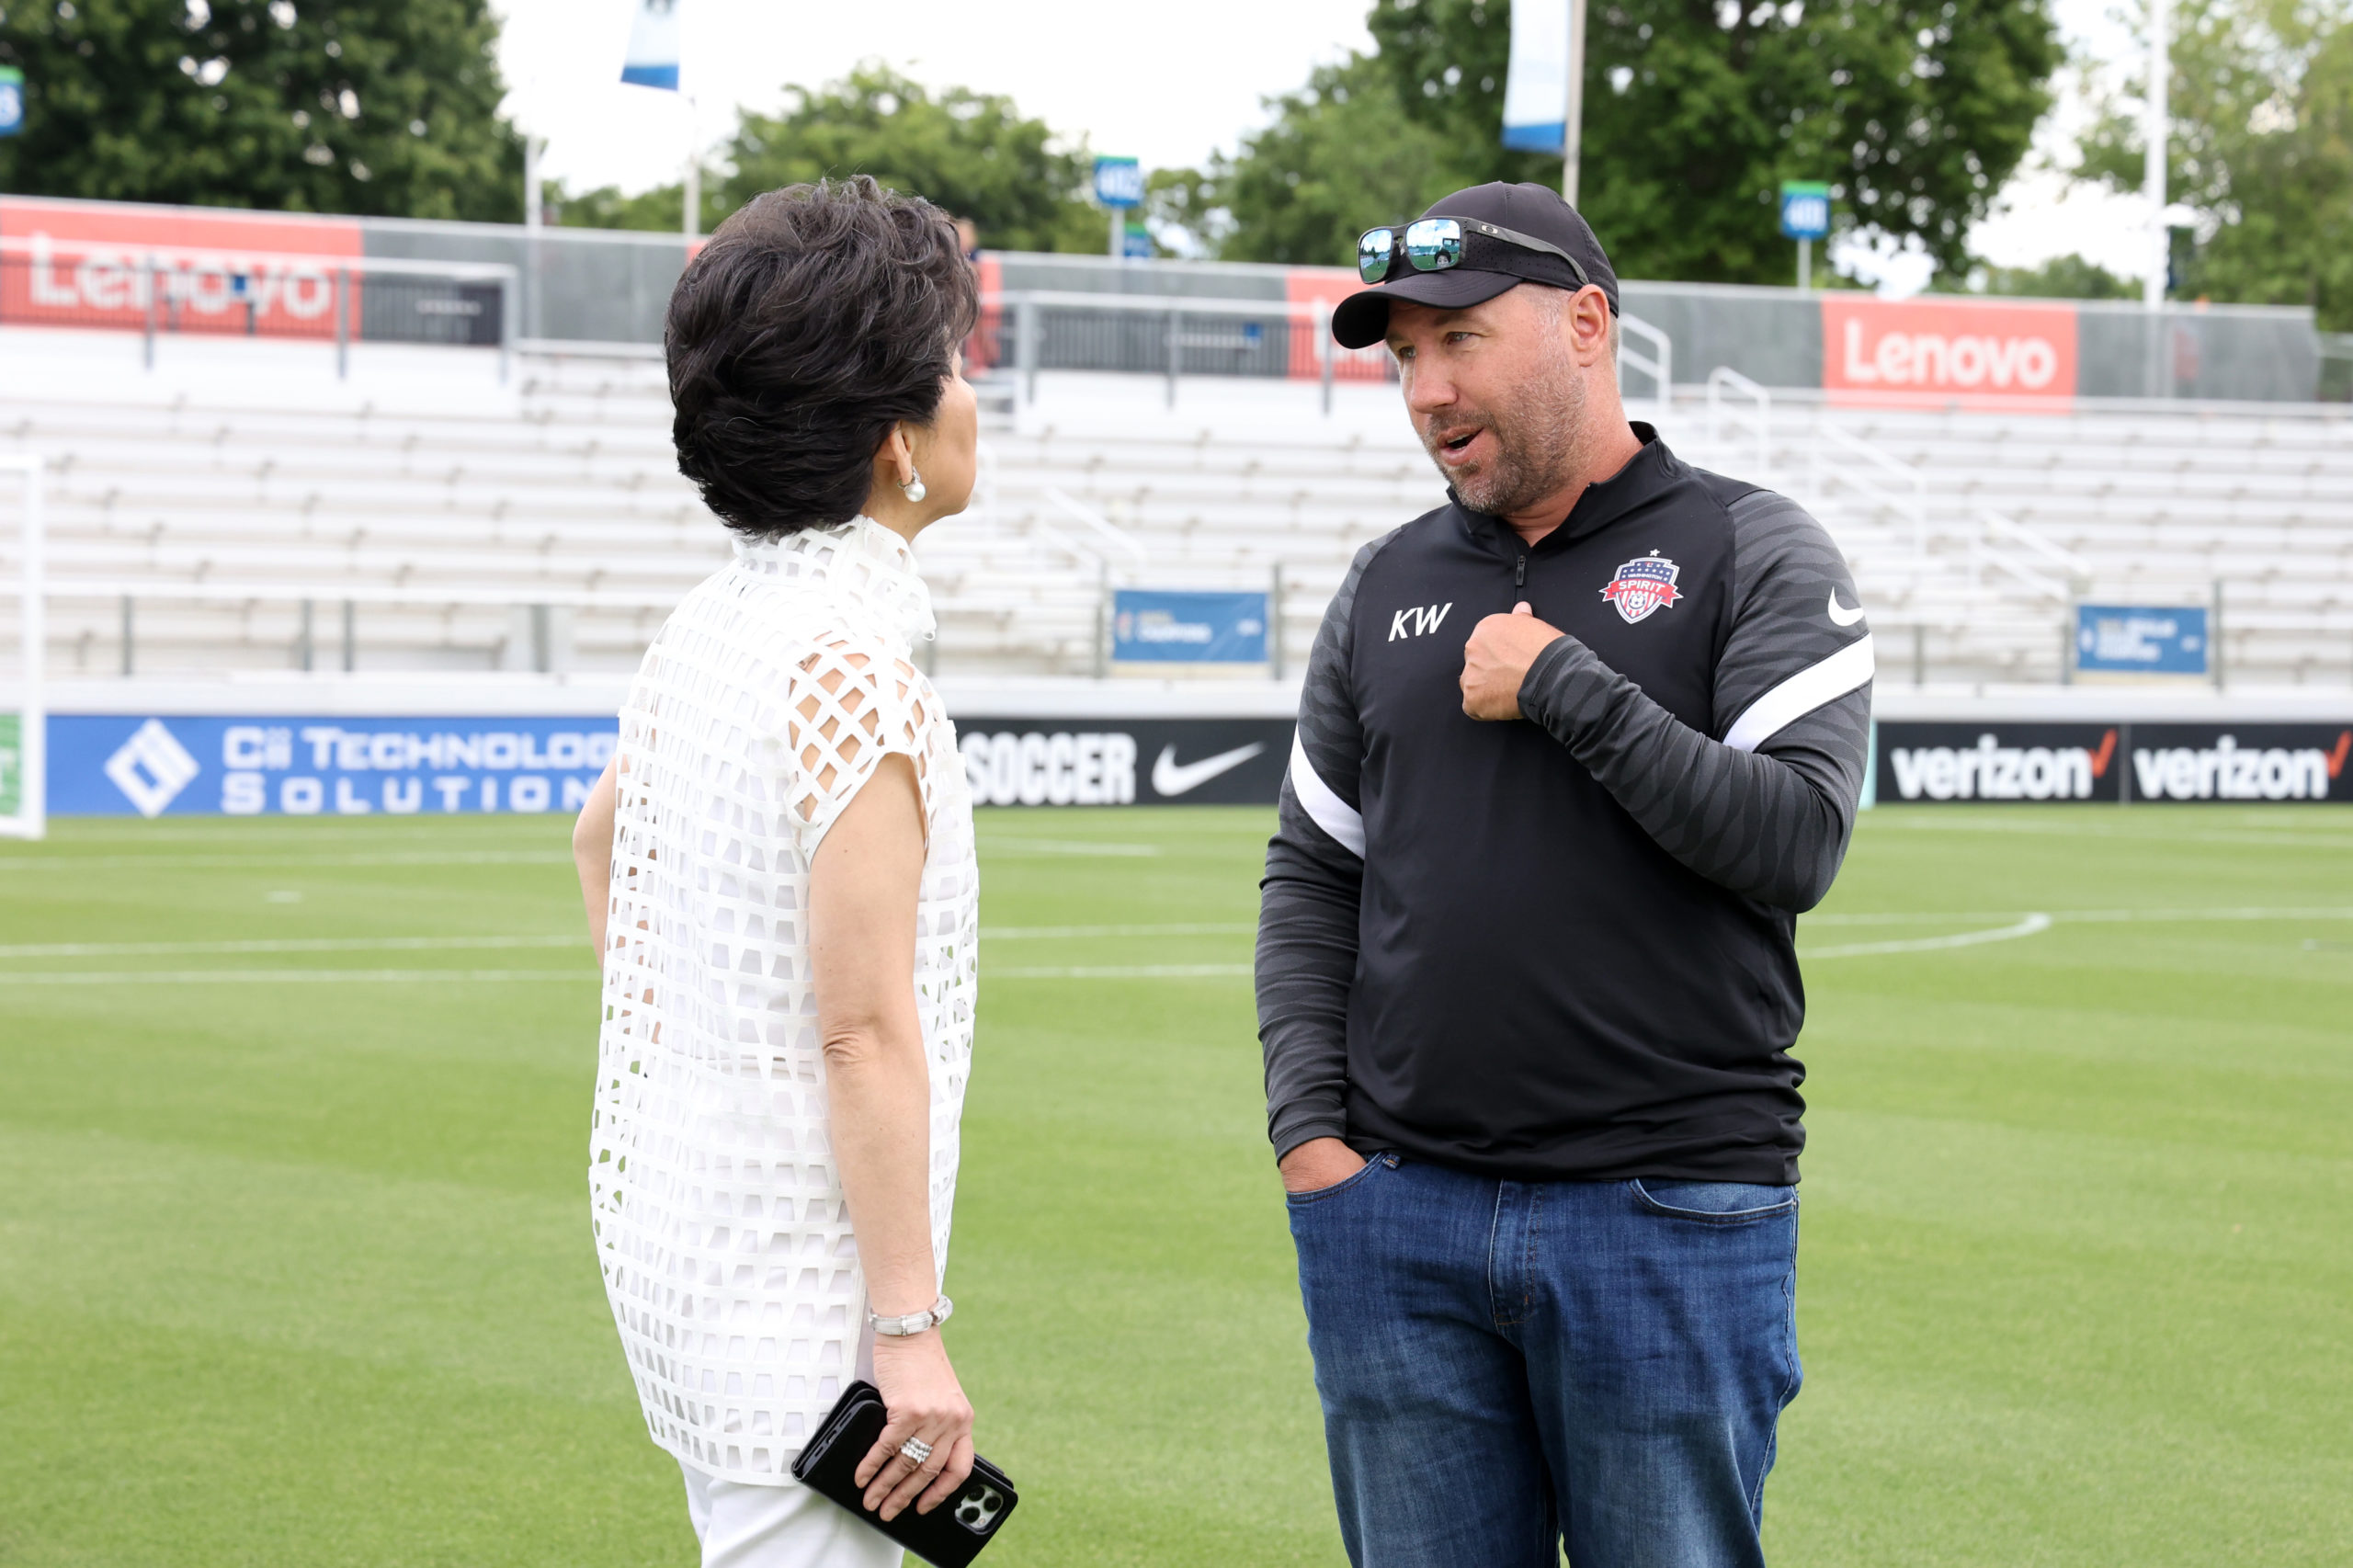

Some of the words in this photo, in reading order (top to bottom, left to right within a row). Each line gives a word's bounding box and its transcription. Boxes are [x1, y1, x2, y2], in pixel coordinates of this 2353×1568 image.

[29, 233, 332, 318] Lenovo
[1843, 318, 2058, 390] Lenovo
[1618, 579, 1665, 593] SPIRIT
[1388, 602, 1453, 642] KW
[959, 732, 1137, 806] SOCCER
[1890, 733, 2093, 800] verizon
[2132, 734, 2329, 800] verizon
